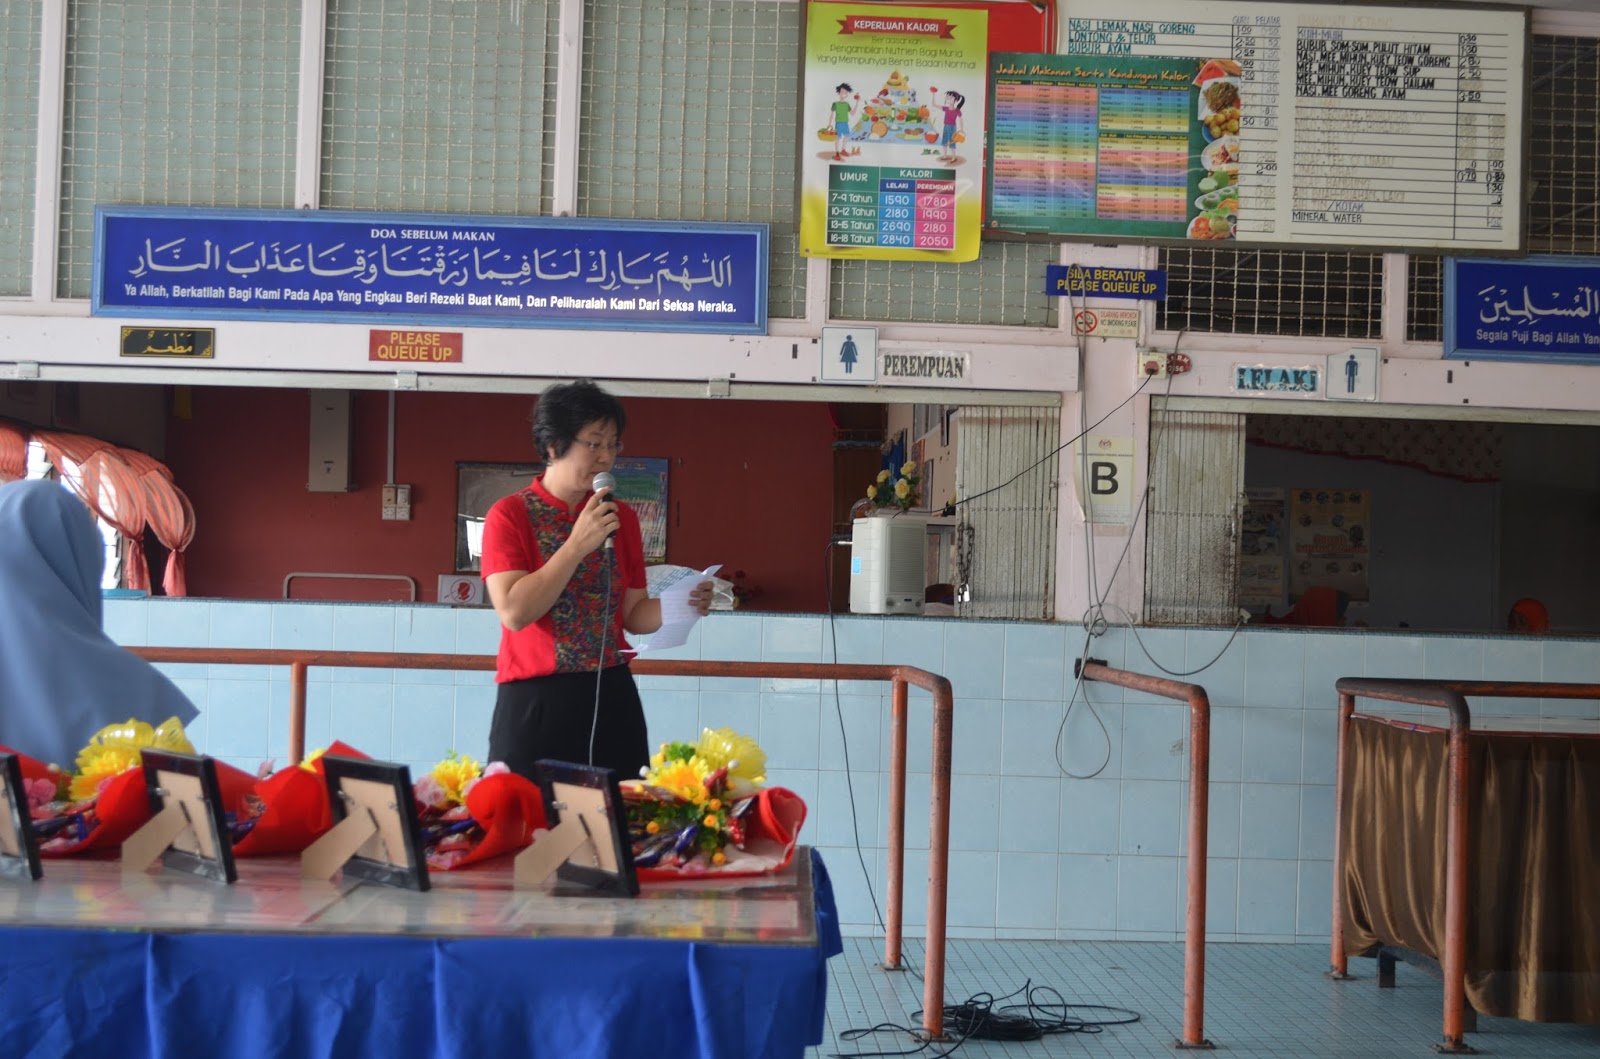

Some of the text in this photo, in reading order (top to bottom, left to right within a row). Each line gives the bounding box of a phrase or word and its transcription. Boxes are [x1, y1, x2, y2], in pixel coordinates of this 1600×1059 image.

[853, 20, 939, 32] KEPERLUAN KALORI
[1069, 19, 1091, 31] NASI
[1132, 22, 1153, 33] NASI
[1159, 23, 1195, 34] GORENG
[871, 36, 923, 45] Berdasarkan
[1069, 31, 1112, 43] LONTONG
[1116, 34, 1125, 44] &
[1129, 33, 1156, 44] TELUR
[830, 44, 963, 58] Pengambilan Nutrien Bagi Murid
[1068, 43, 1101, 54] BUBUR
[1107, 43, 1131, 54] AYAM
[1296, 39, 1326, 51] BUBUR
[1373, 42, 1399, 54] PULUT
[1404, 43, 1431, 55] HITAM
[816, 54, 977, 69] Yang Mempunyai Berat Badan Normal
[1394, 54, 1415, 66] TEOW
[1418, 55, 1451, 67] GORENG
[996, 63, 1027, 75] Jadual
[1030, 65, 1071, 77] Makanan
[1074, 66, 1105, 78] Serta
[1109, 68, 1158, 83] Kandungan
[1161, 69, 1191, 81] Kalori
[1375, 65, 1398, 76] TEOW
[1403, 66, 1421, 77] SUP
[1375, 76, 1398, 87] TEOW
[1343, 87, 1376, 98] GORENG
[1382, 88, 1406, 100] AYAM
[839, 169, 933, 182] UMUR KALORI
[886, 182, 954, 192] LELAKI PEREMPUAN
[832, 192, 948, 208] 7-9 Tahun 1590 1780
[831, 206, 948, 221] 10-12 Tahun 2180 1990
[1292, 211, 1362, 223] MINERAL WATER
[850, 220, 875, 230] Tahun
[882, 221, 911, 232] 2690
[923, 222, 947, 234] 2180
[371, 228, 495, 242] DOA SEBELUM MAKAN
[830, 233, 949, 247] 16-18 Tahun 2840 2050
[1068, 269, 1146, 282] SILA BERATUR
[1057, 279, 1157, 294] PLEASE QUEUE UP
[125, 284, 737, 313] Ya Allah, Berkatilah Bagi Kami Pada Apa Yang Engkau Beri Rezeki Buat Kami, Dan Peliharalah Kami Dari Seksa Neraka.
[390, 332, 441, 346] PLEASE
[1476, 328, 1600, 345] Segala Puji Bagi Allah Yan
[377, 344, 453, 361] QUEUE UP
[883, 354, 964, 379] PEREMPUAN
[1237, 367, 1317, 392] LELAKI
[1091, 461, 1119, 495] B
